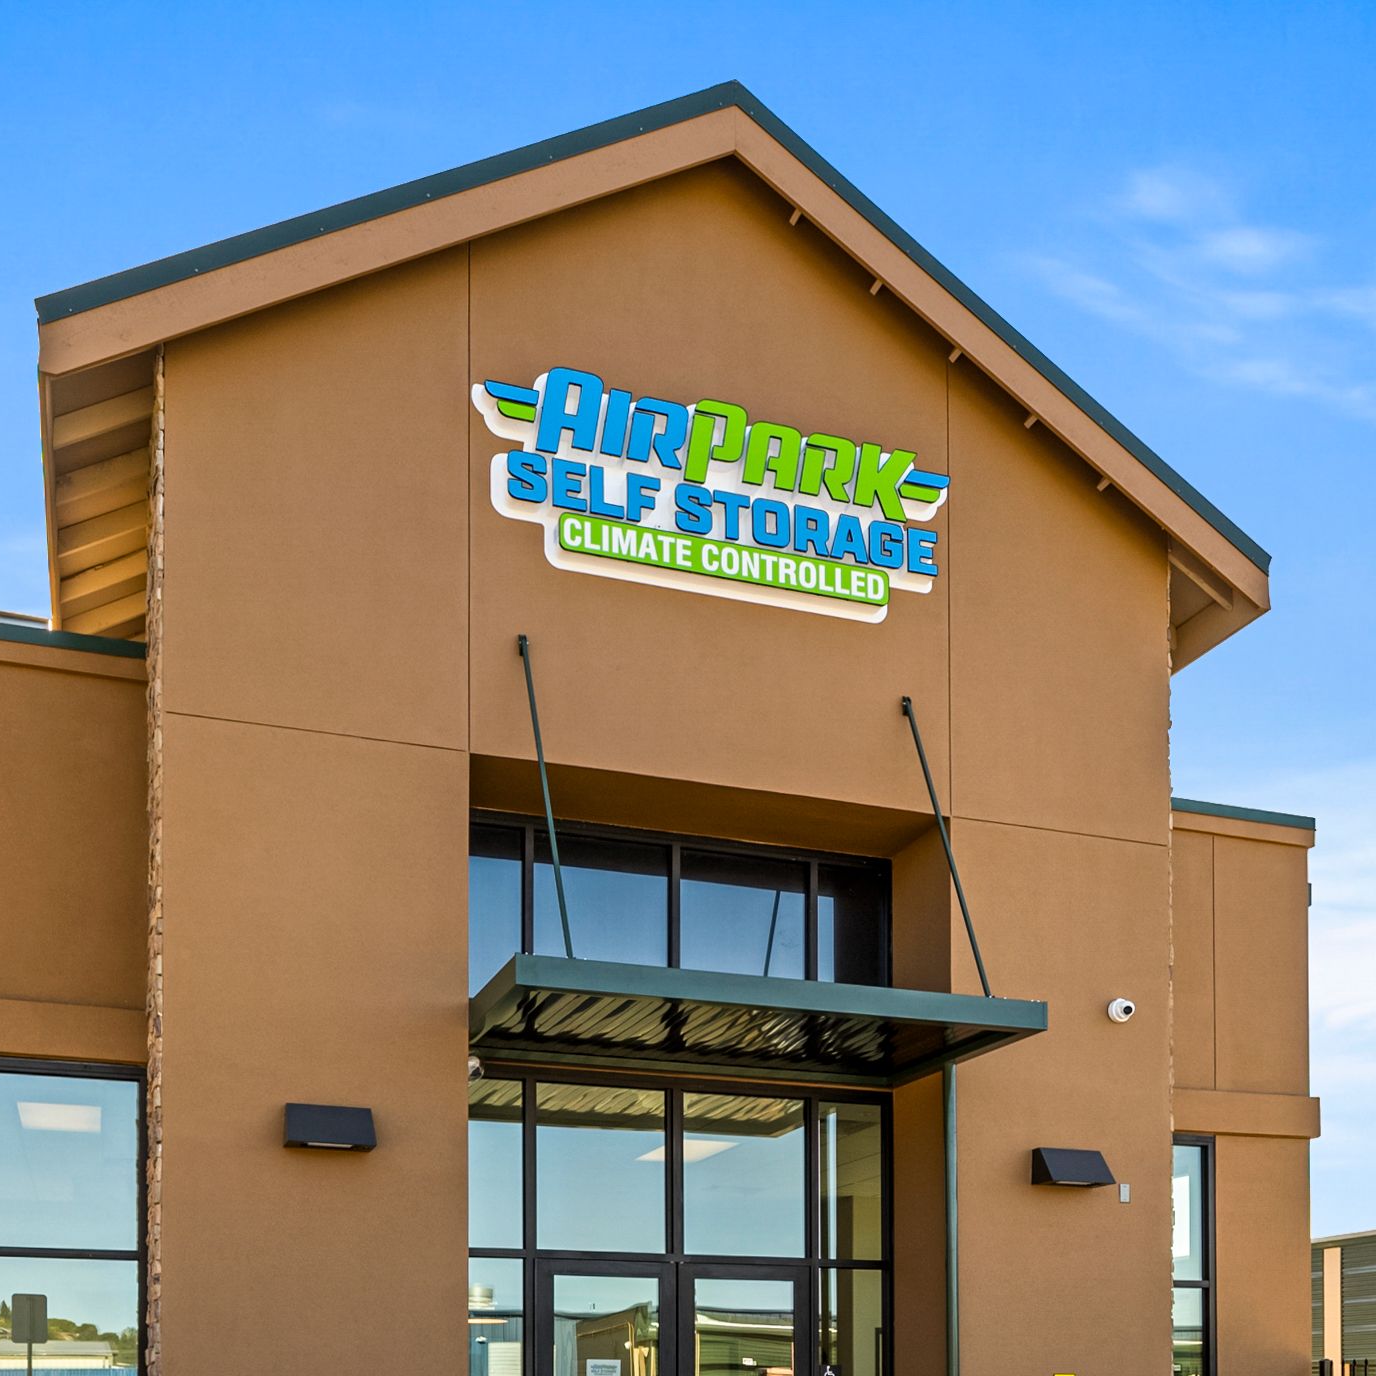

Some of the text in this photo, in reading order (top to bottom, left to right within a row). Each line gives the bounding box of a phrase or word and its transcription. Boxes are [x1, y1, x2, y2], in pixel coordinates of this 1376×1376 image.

[507, 449, 939, 578] SELF STORAGE
[562, 517, 886, 602] CLIMATE CONTROLLED
